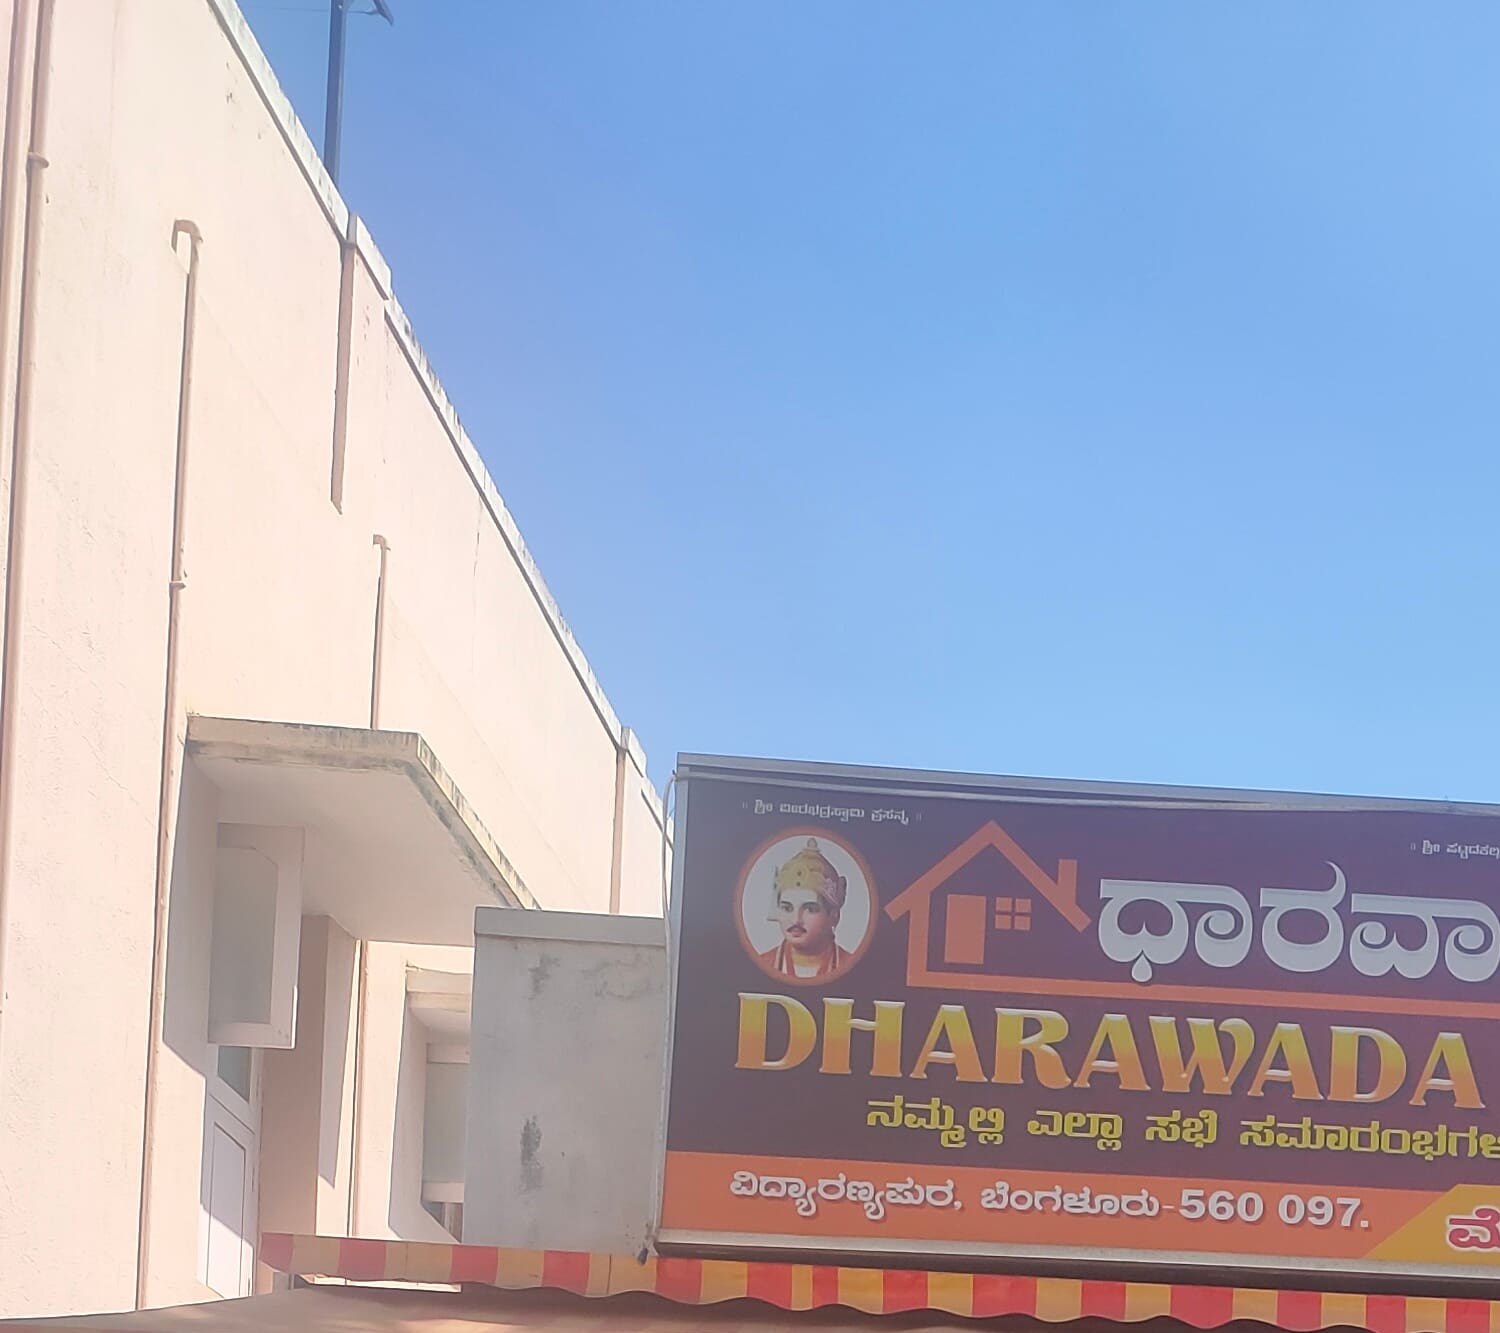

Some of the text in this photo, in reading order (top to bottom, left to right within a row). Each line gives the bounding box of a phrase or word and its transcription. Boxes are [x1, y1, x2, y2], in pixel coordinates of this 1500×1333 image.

[734, 992, 1486, 1110] DHARAWADA
[866, 1095, 1005, 1148] ನಮ್ಮಲ್ಲಿ
[1027, 1109, 1123, 1151] ಎಲ್ಲಾ
